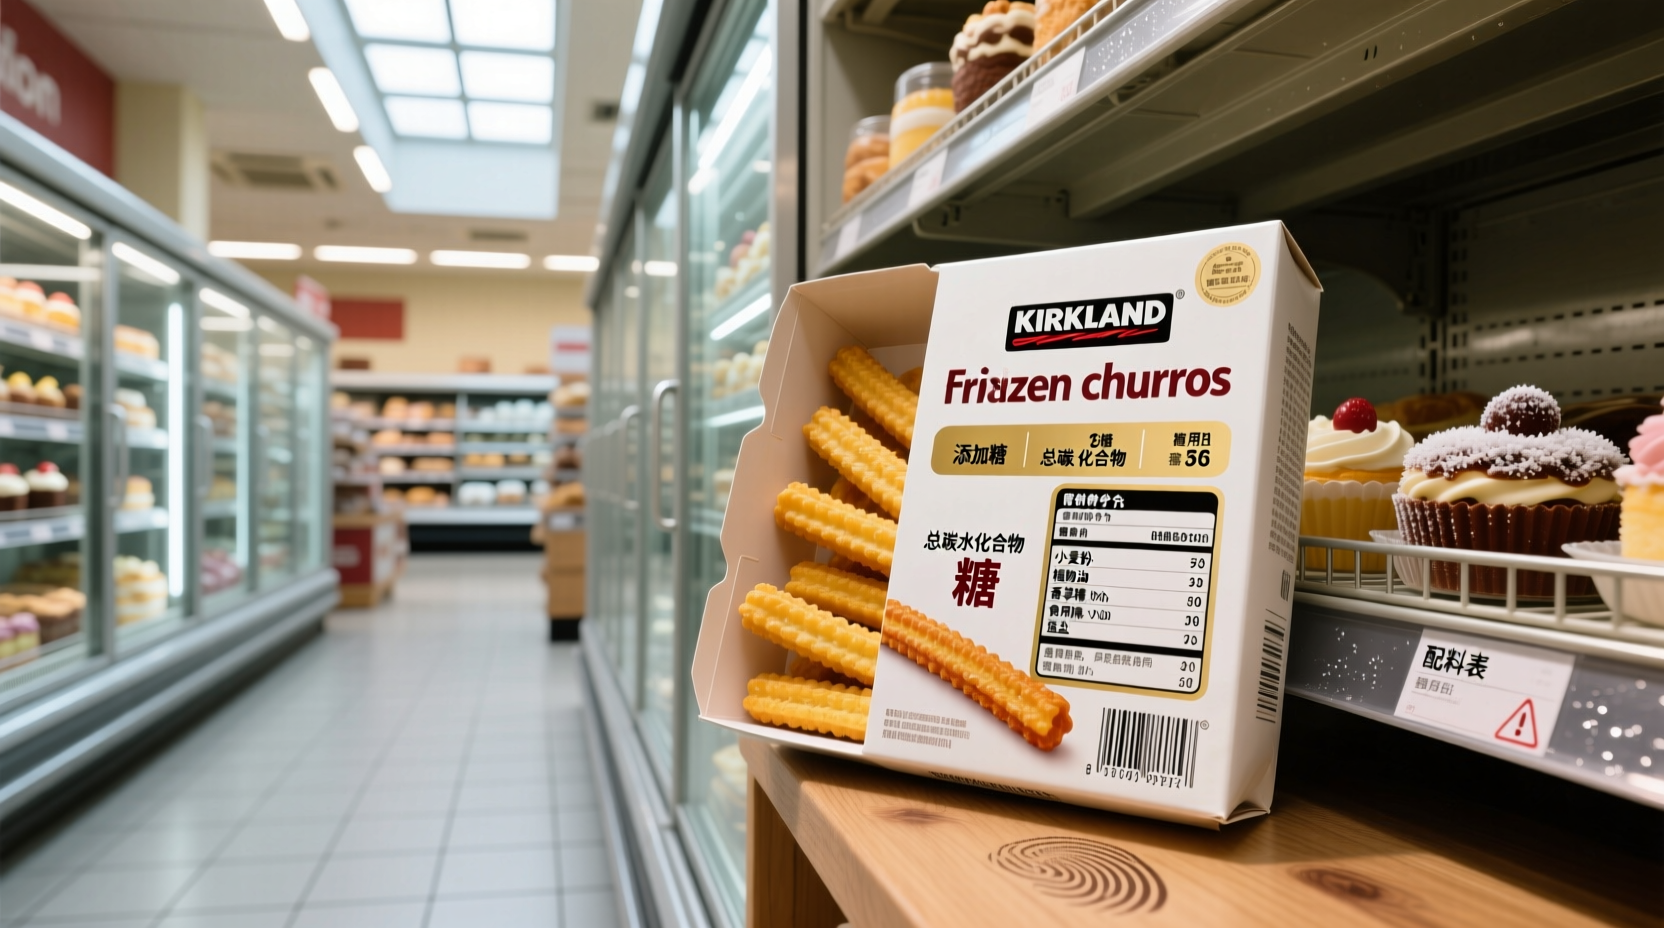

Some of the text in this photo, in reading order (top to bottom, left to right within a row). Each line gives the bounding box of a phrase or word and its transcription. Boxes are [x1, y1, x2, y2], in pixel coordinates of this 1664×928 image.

[1014, 300, 1167, 334] KIRKLAND
[1081, 362, 1232, 401] churros
[953, 443, 1008, 466] 添加糖
[923, 529, 1025, 554] 总碳水化合物
[952, 557, 1001, 608] 糖
[1422, 644, 1490, 680] 配料表
